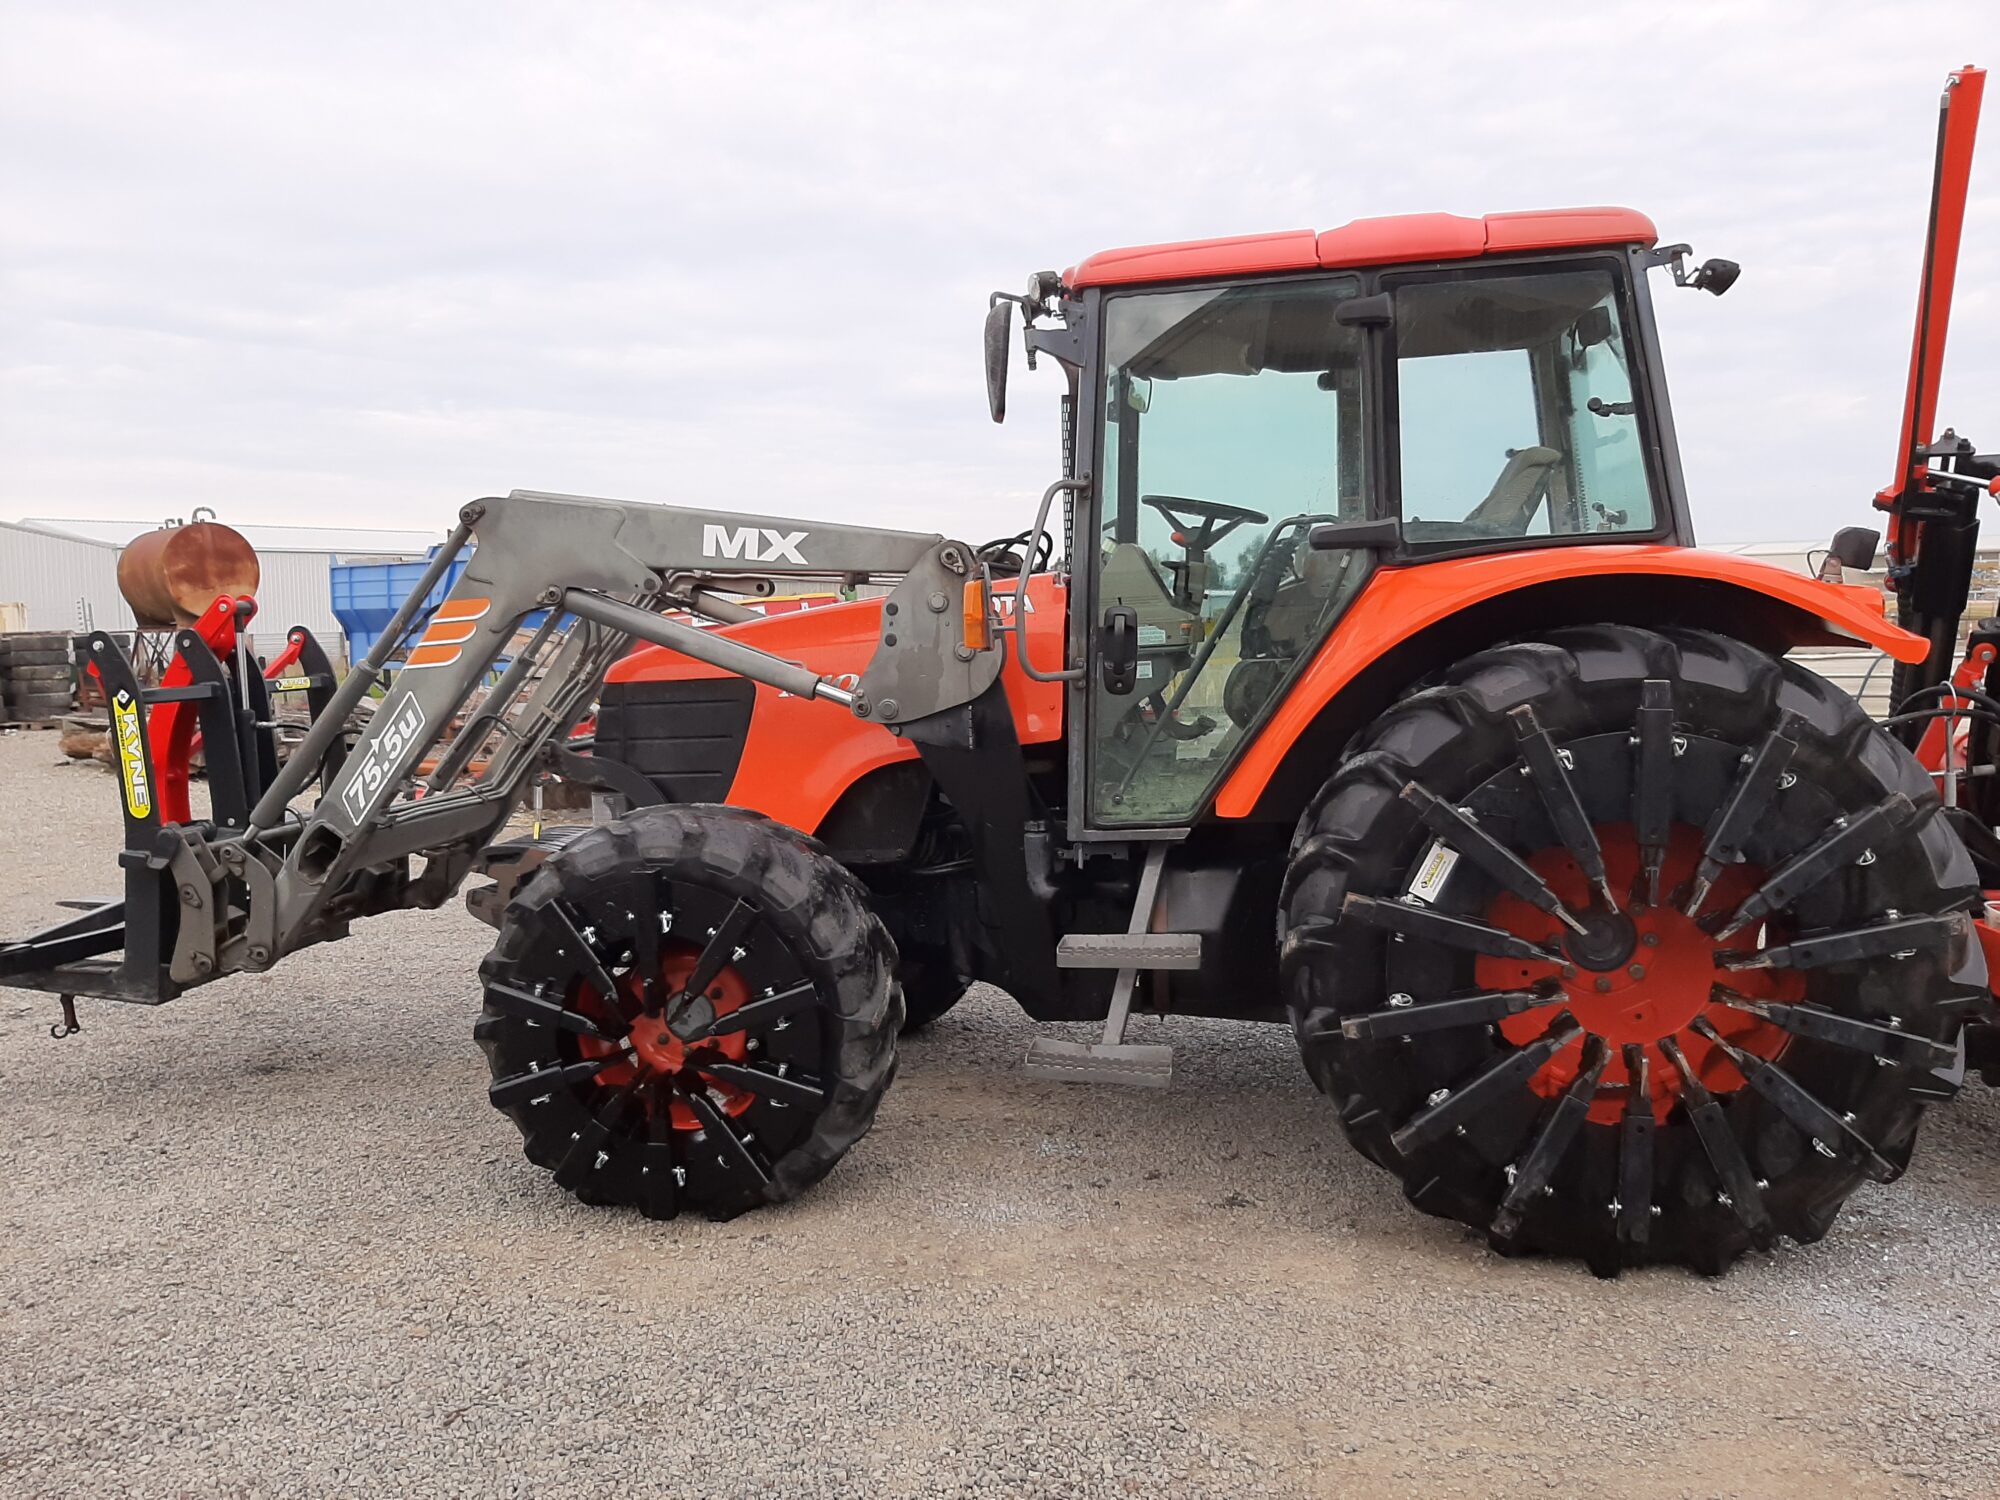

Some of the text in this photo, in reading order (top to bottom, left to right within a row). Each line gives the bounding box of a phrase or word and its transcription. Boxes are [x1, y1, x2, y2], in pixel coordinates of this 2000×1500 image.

[703, 524, 809, 565] MX
[122, 713, 149, 808] KYNE
[348, 709, 418, 809] 75.5u
